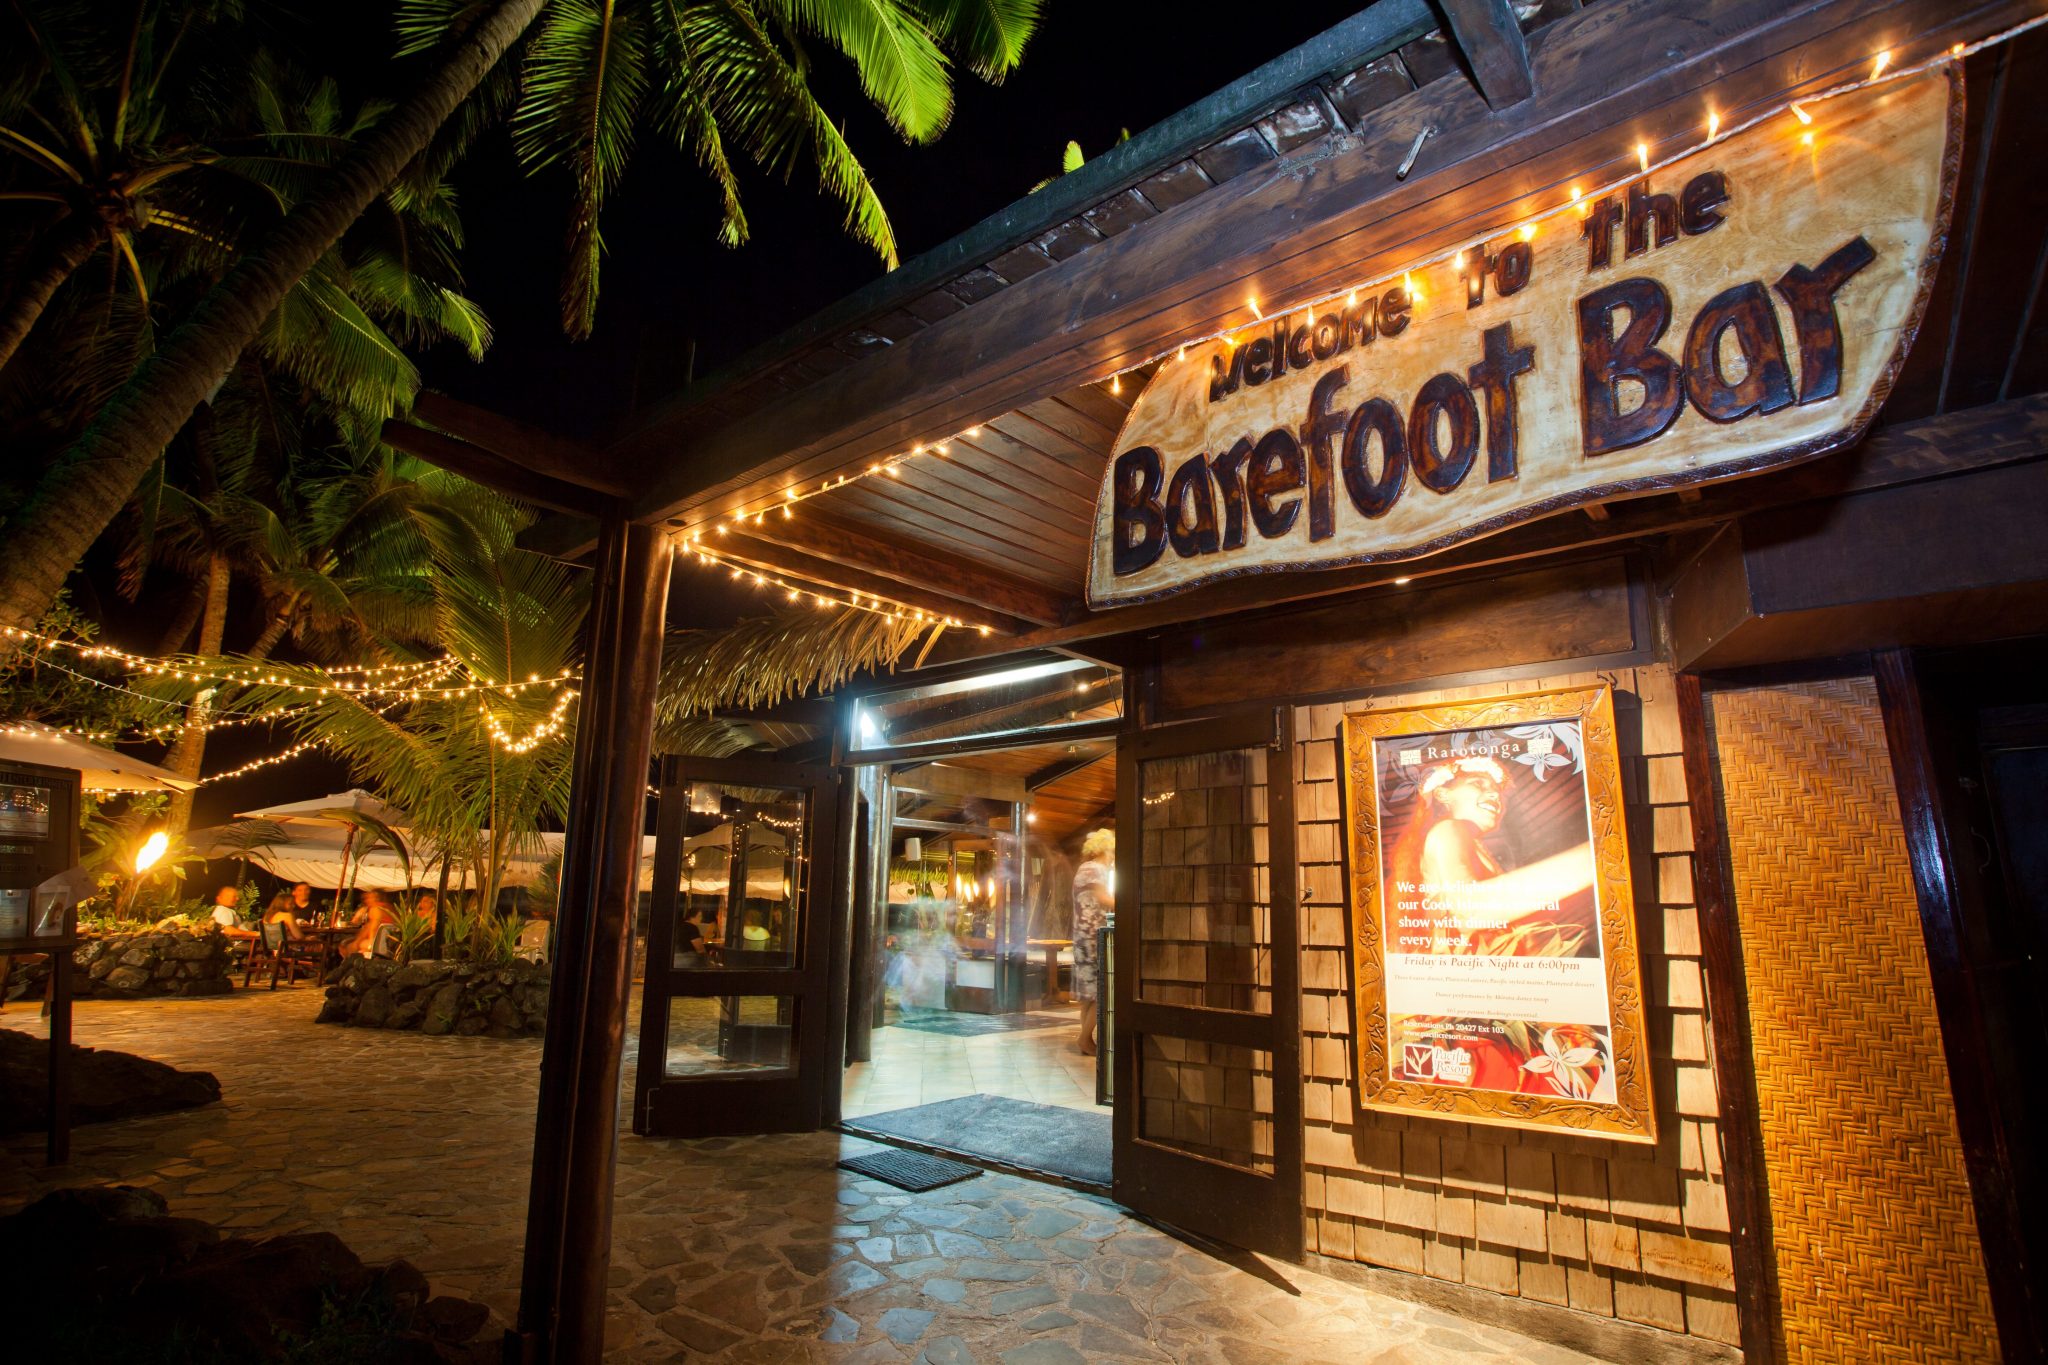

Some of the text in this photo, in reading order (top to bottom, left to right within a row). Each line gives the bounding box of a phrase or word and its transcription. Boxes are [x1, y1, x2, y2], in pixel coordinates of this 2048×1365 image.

[1459, 243, 1533, 308] to
[1579, 170, 1731, 273] the
[1113, 236, 1876, 575] Barefoot Bar
[1428, 743, 1521, 759] Rarotonga
[1397, 882, 1415, 893] We
[1398, 900, 1418, 911] our
[1399, 915, 1509, 929] show with dinner
[1400, 935, 1472, 948] every week.
[1404, 956, 1580, 973] Friday is Pacific Night at 6:00pm
[1403, 1029, 1478, 1041] www.pacificresort.com
[1456, 1024, 1477, 1032] 20427
[1492, 1026, 1505, 1034] 103
[1435, 1047, 1470, 1062] Pacific
[1436, 1060, 1470, 1075] Resort
